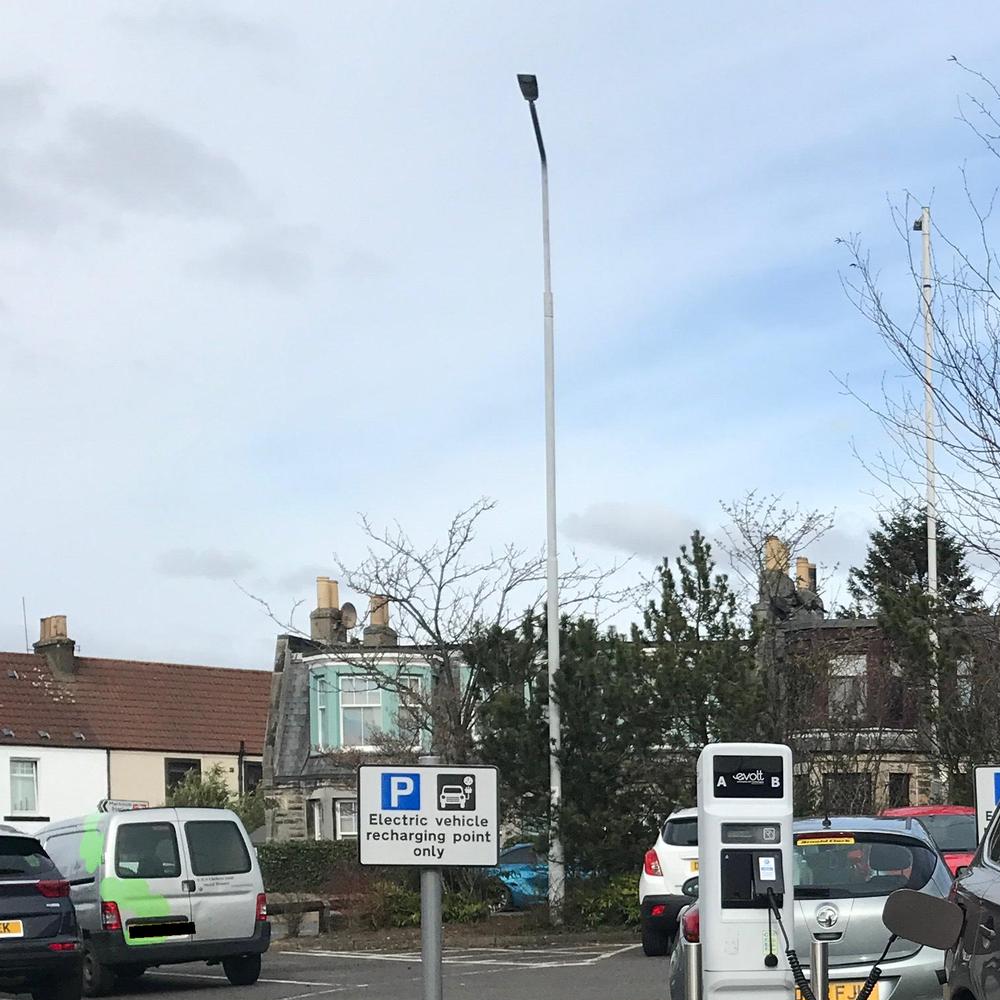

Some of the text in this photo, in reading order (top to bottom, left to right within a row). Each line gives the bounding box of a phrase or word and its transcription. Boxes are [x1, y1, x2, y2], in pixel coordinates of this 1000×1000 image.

[716, 776, 727, 787] A
[732, 770, 765, 781] evolt
[771, 776, 781, 788] B
[390, 776, 414, 808] P
[369, 813, 489, 827] Electric vehicle
[366, 829, 491, 844] recharging point
[413, 845, 445, 859] only
